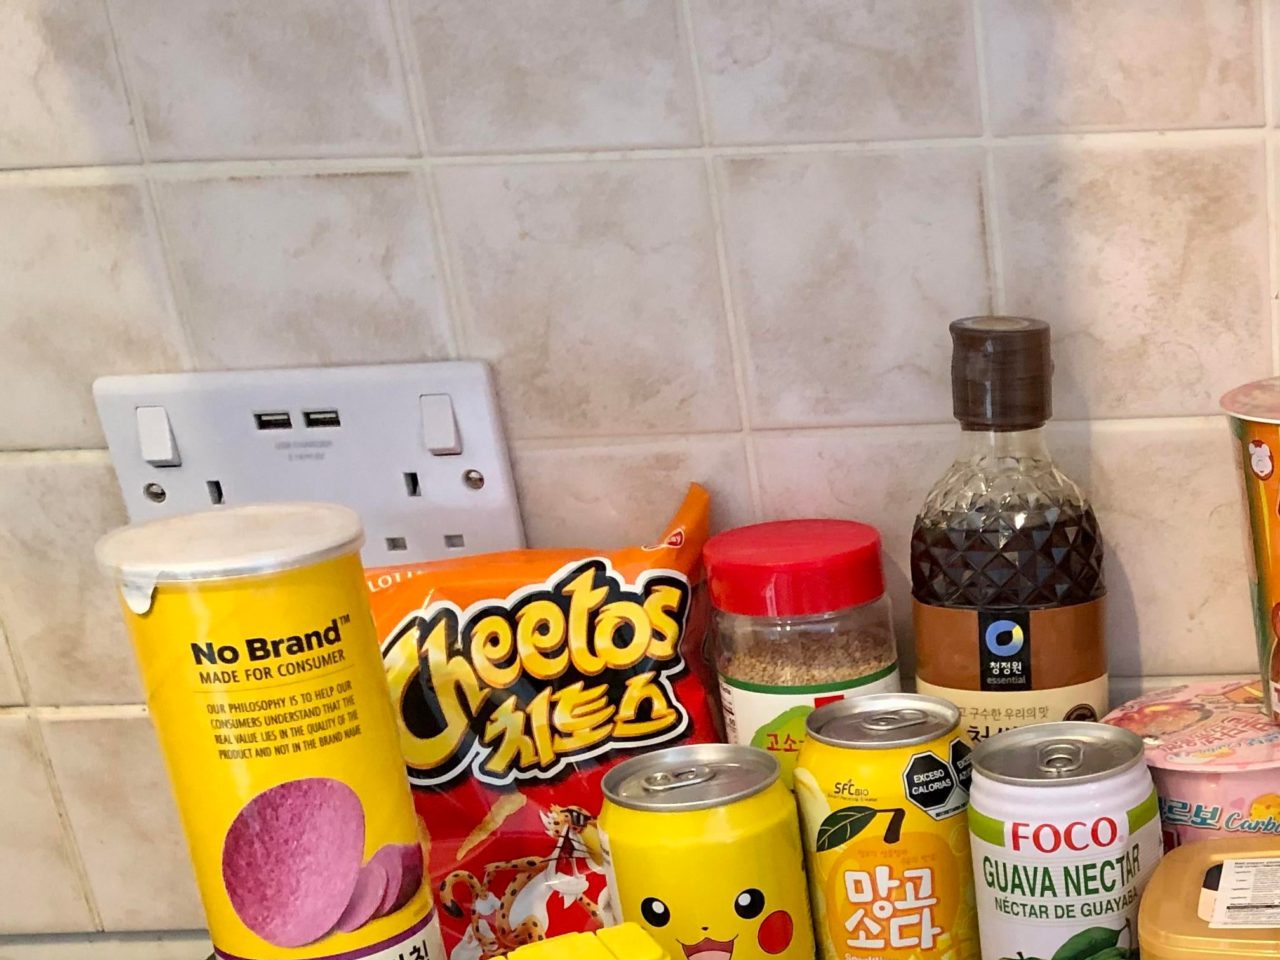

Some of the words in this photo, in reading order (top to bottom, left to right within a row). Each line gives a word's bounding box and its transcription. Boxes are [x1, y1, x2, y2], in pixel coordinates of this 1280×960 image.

[191, 642, 240, 665] No
[199, 670, 240, 685] MADE
[245, 666, 274, 682] FOR
[277, 649, 346, 678] CONSUMER
[383, 564, 683, 770] Cheetos
[989, 661, 1023, 676] 청정원
[986, 675, 1027, 685] essential
[207, 703, 228, 715] OUR
[228, 697, 287, 714] PHILOSOPHY
[289, 694, 298, 706] IS
[300, 691, 313, 704] TO
[314, 686, 335, 702] HELP
[336, 680, 353, 695] OUR
[210, 717, 262, 730] CONSUMERS
[264, 706, 322, 727] UNDERSTAND
[322, 699, 341, 715] THAT
[342, 695, 356, 708] THE
[290, 724, 305, 738] THE
[306, 716, 337, 735] QUALITY
[484, 670, 678, 774] 치토스
[766, 733, 804, 753] 고소
[911, 778, 952, 796] CALORIAS
[913, 769, 945, 784] EXCESO
[1160, 799, 1221, 830] 르보
[1011, 816, 1118, 854] FOCO
[983, 855, 1058, 898] GUAVA
[1063, 843, 1141, 898] NECTAR
[844, 865, 938, 919] 망고
[994, 896, 1049, 919] NÉCTAR
[1054, 903, 1077, 919] DE
[1080, 885, 1139, 917] GUAYABA
[844, 907, 942, 950] 소다
